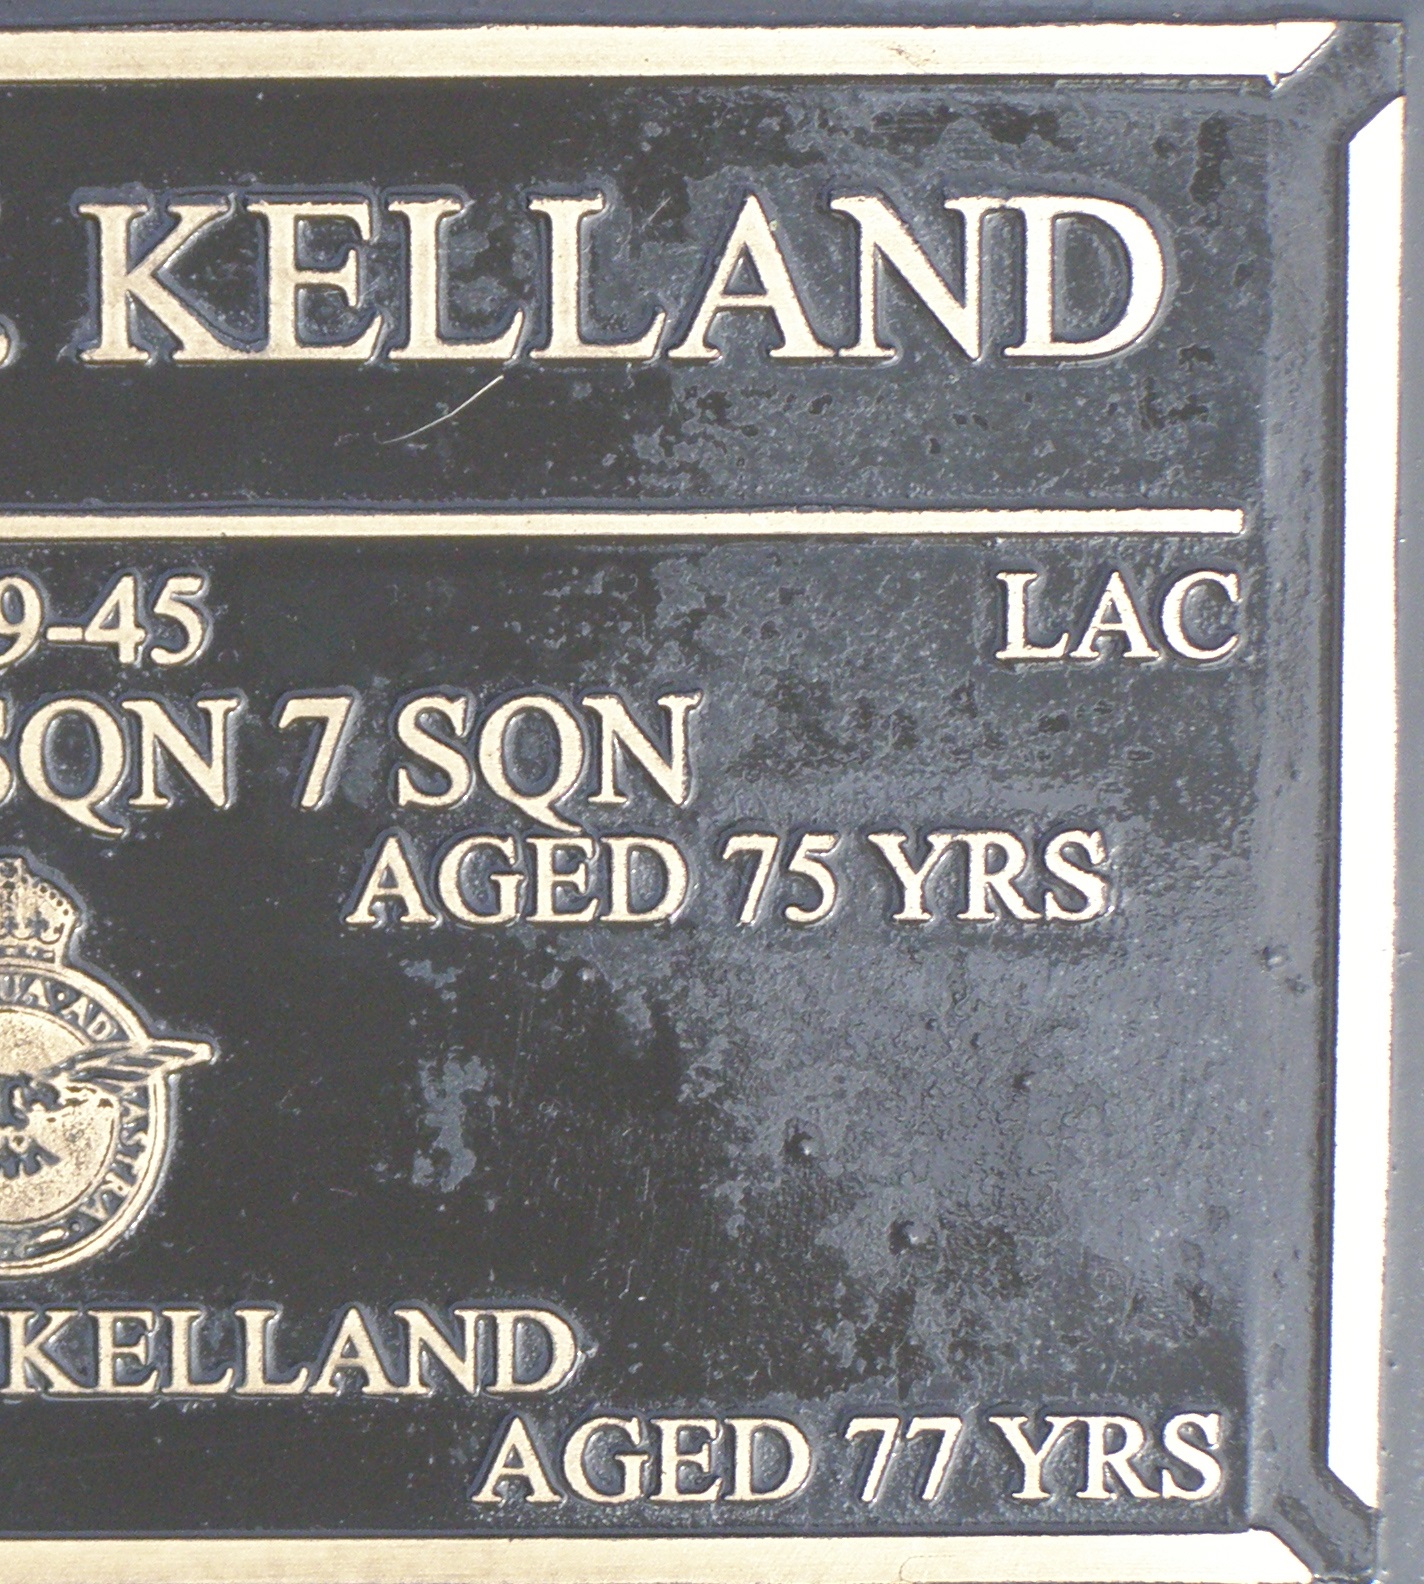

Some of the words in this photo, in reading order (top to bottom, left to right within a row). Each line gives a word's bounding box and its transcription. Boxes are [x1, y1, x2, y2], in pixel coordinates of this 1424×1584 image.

[78, 192, 1166, 366] KELLAND
[994, 570, 1245, 666] LAC
[277, 695, 358, 810] 7
[396, 692, 702, 835] SQN
[345, 835, 692, 929] AGED
[721, 832, 845, 928] 75
[867, 829, 1109, 925] YRS
[61, 995, 113, 1041] AD
[78, 1101, 149, 1221] ASTRA
[0, 1307, 583, 1398] KELLAND
[471, 1416, 817, 1507] AGED
[844, 1415, 968, 1509] 77
[987, 1412, 1226, 1503] YRS
